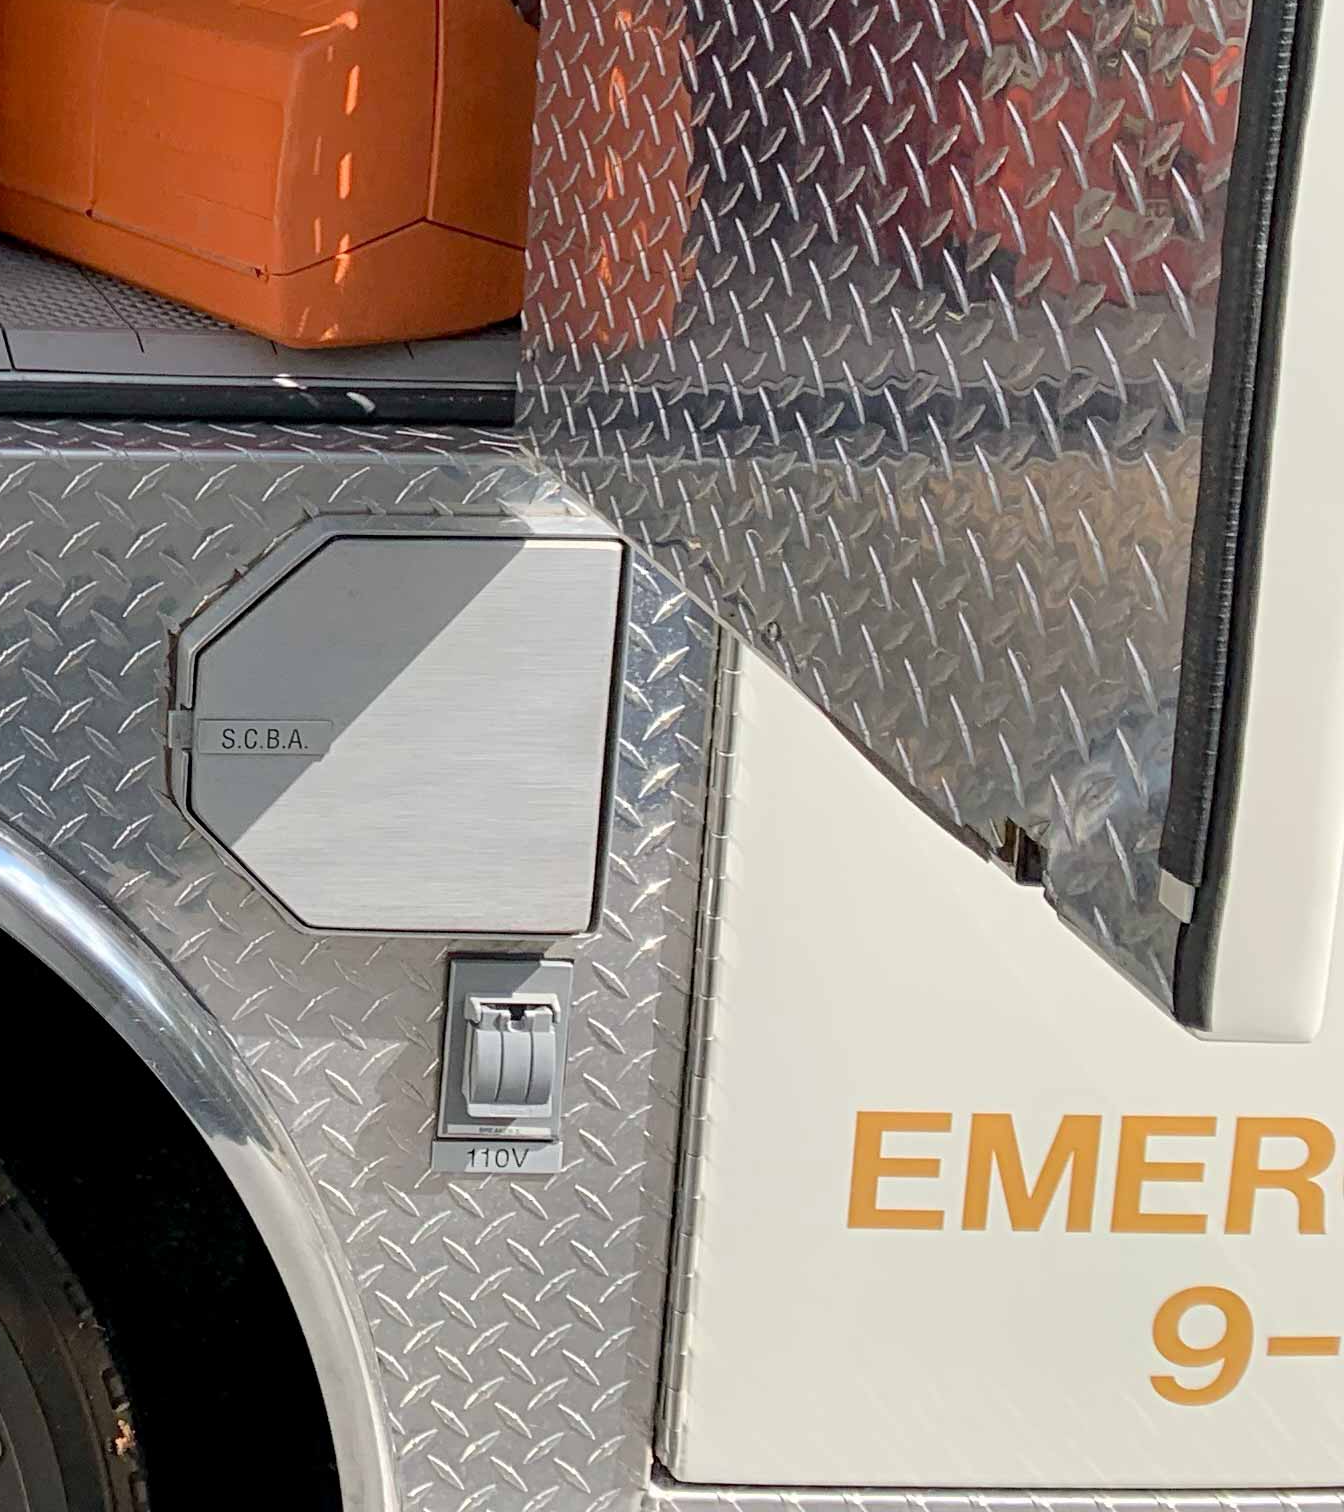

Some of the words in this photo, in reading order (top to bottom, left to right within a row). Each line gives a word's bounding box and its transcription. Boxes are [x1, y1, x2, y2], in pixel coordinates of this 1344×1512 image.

[221, 728, 309, 749] S.C.B.A.
[466, 1148, 529, 1168] 110V
[847, 1110, 1337, 1236] EMER
[1149, 1285, 1341, 1407] 9-
